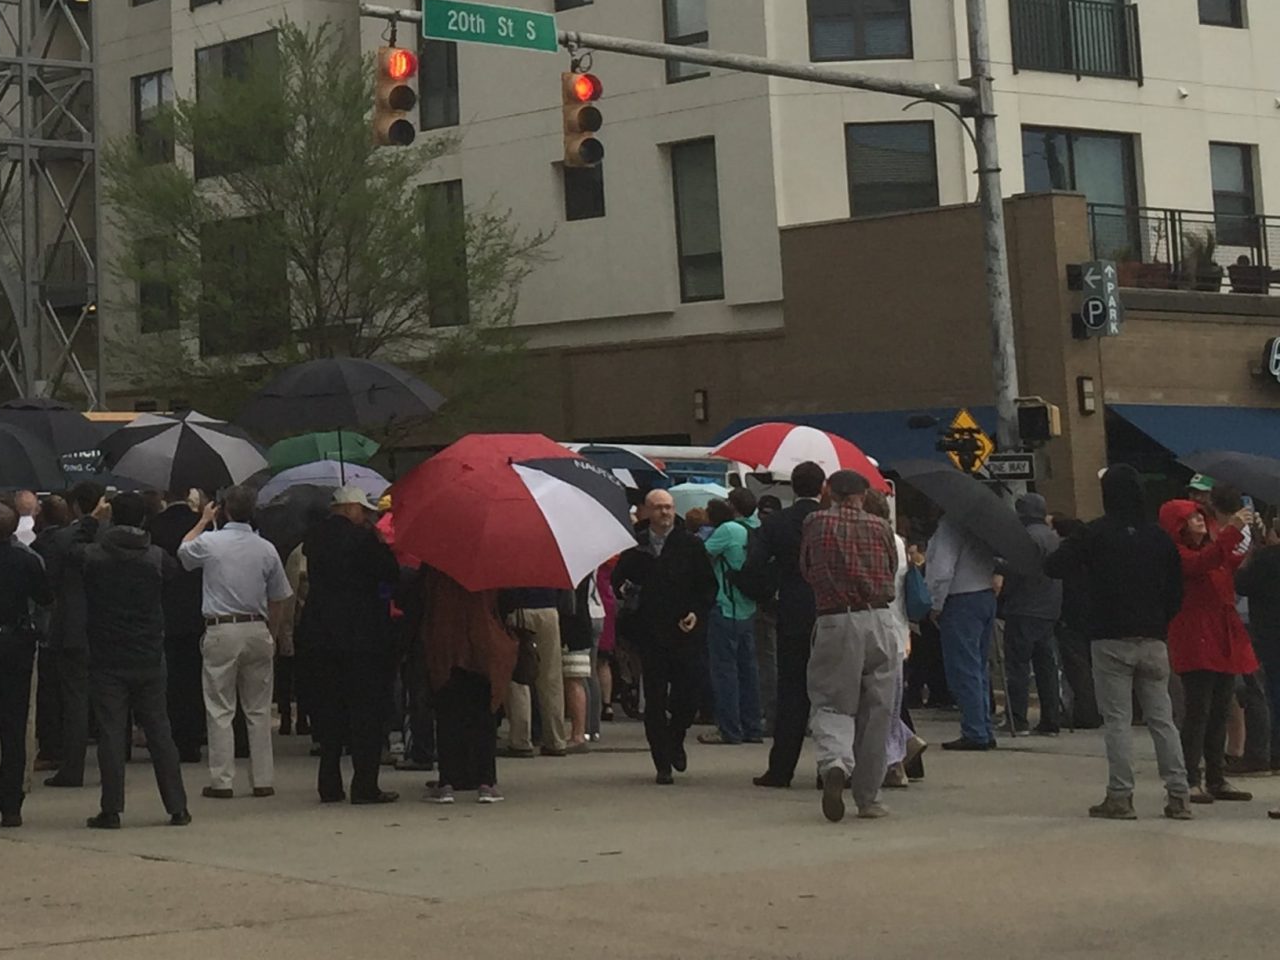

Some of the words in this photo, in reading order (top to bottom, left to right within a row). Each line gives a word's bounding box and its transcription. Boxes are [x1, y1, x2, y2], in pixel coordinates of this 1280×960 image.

[447, 10, 486, 34] 20th
[497, 17, 514, 38] St
[526, 20, 536, 40] S
[1088, 300, 1103, 325] P
[1106, 282, 1118, 334] PARK
[1008, 462, 1026, 472] WAY
